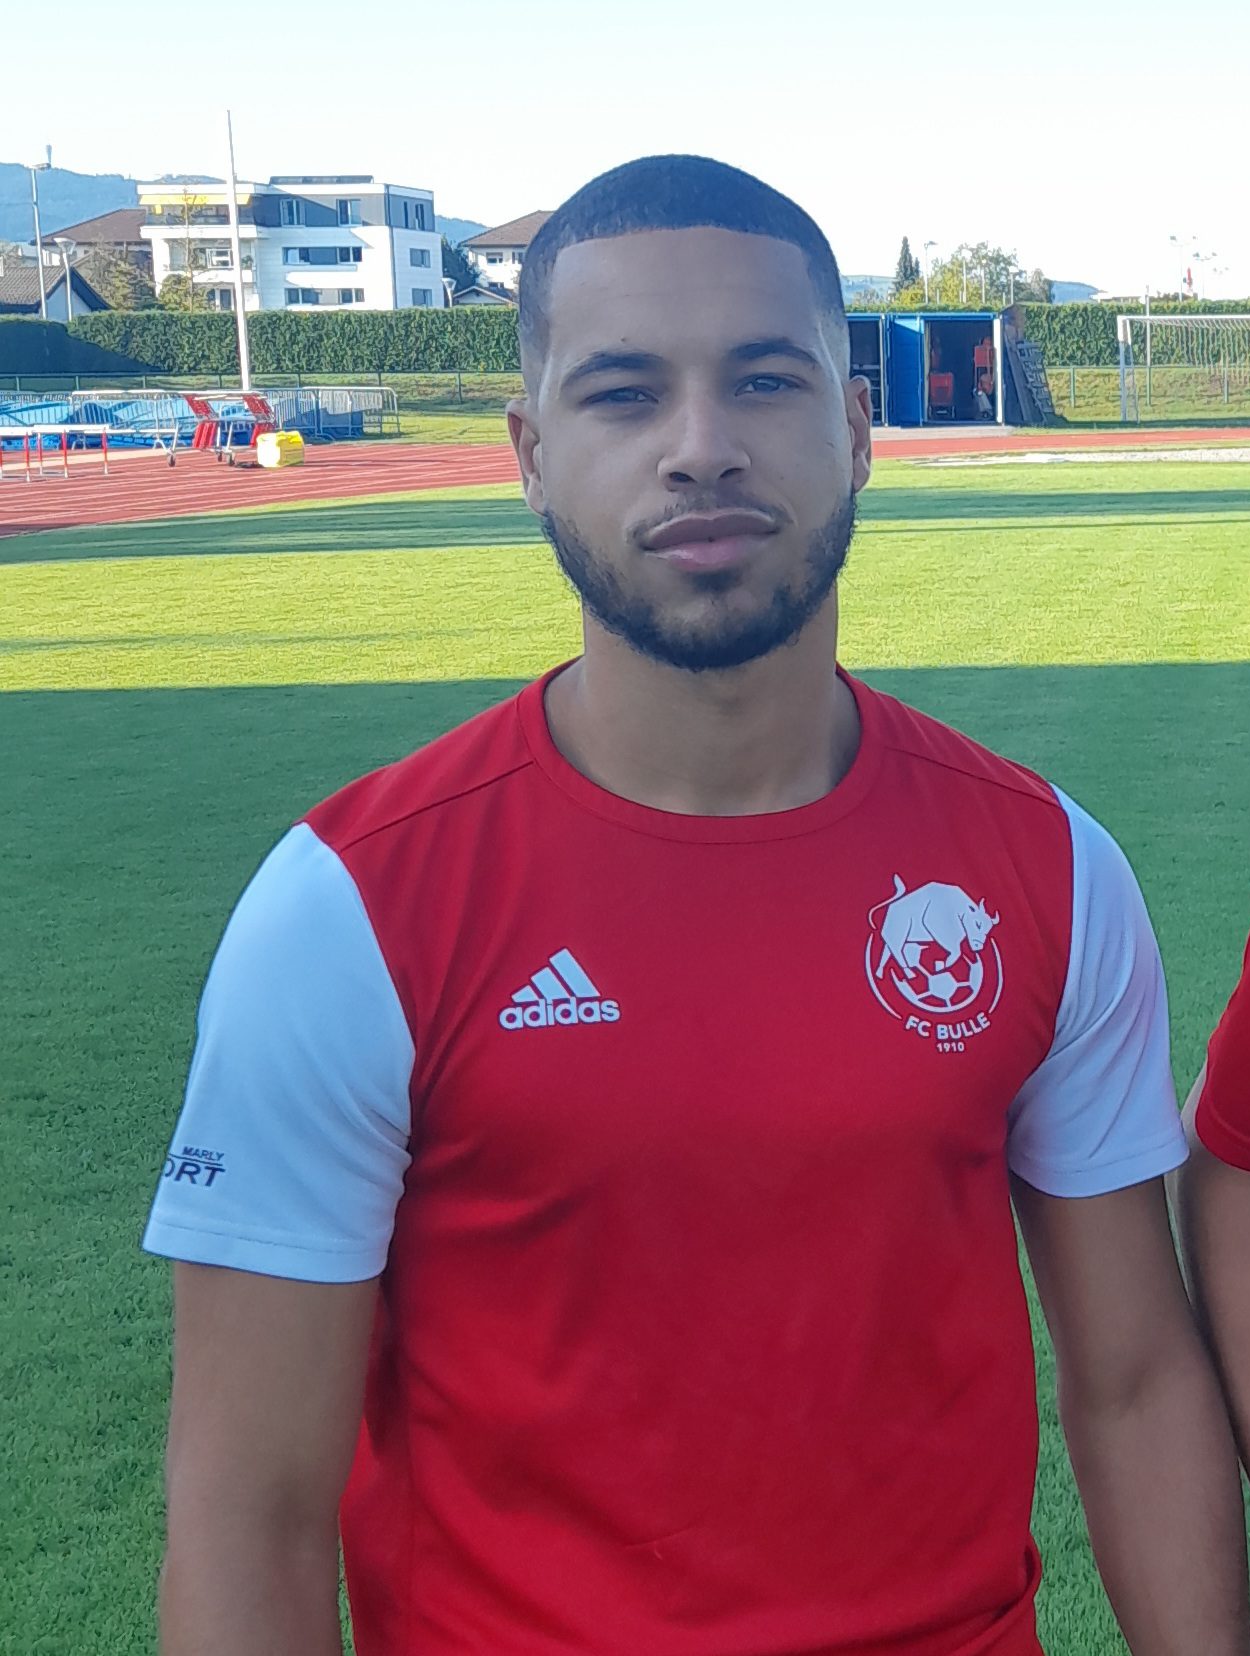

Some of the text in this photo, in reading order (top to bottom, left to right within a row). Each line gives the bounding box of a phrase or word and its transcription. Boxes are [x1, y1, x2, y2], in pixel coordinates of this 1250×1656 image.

[499, 996, 621, 1030] adidas
[905, 1011, 991, 1040] FC BULLE
[936, 1041, 965, 1053] 1910
[182, 1146, 225, 1162] MARLY
